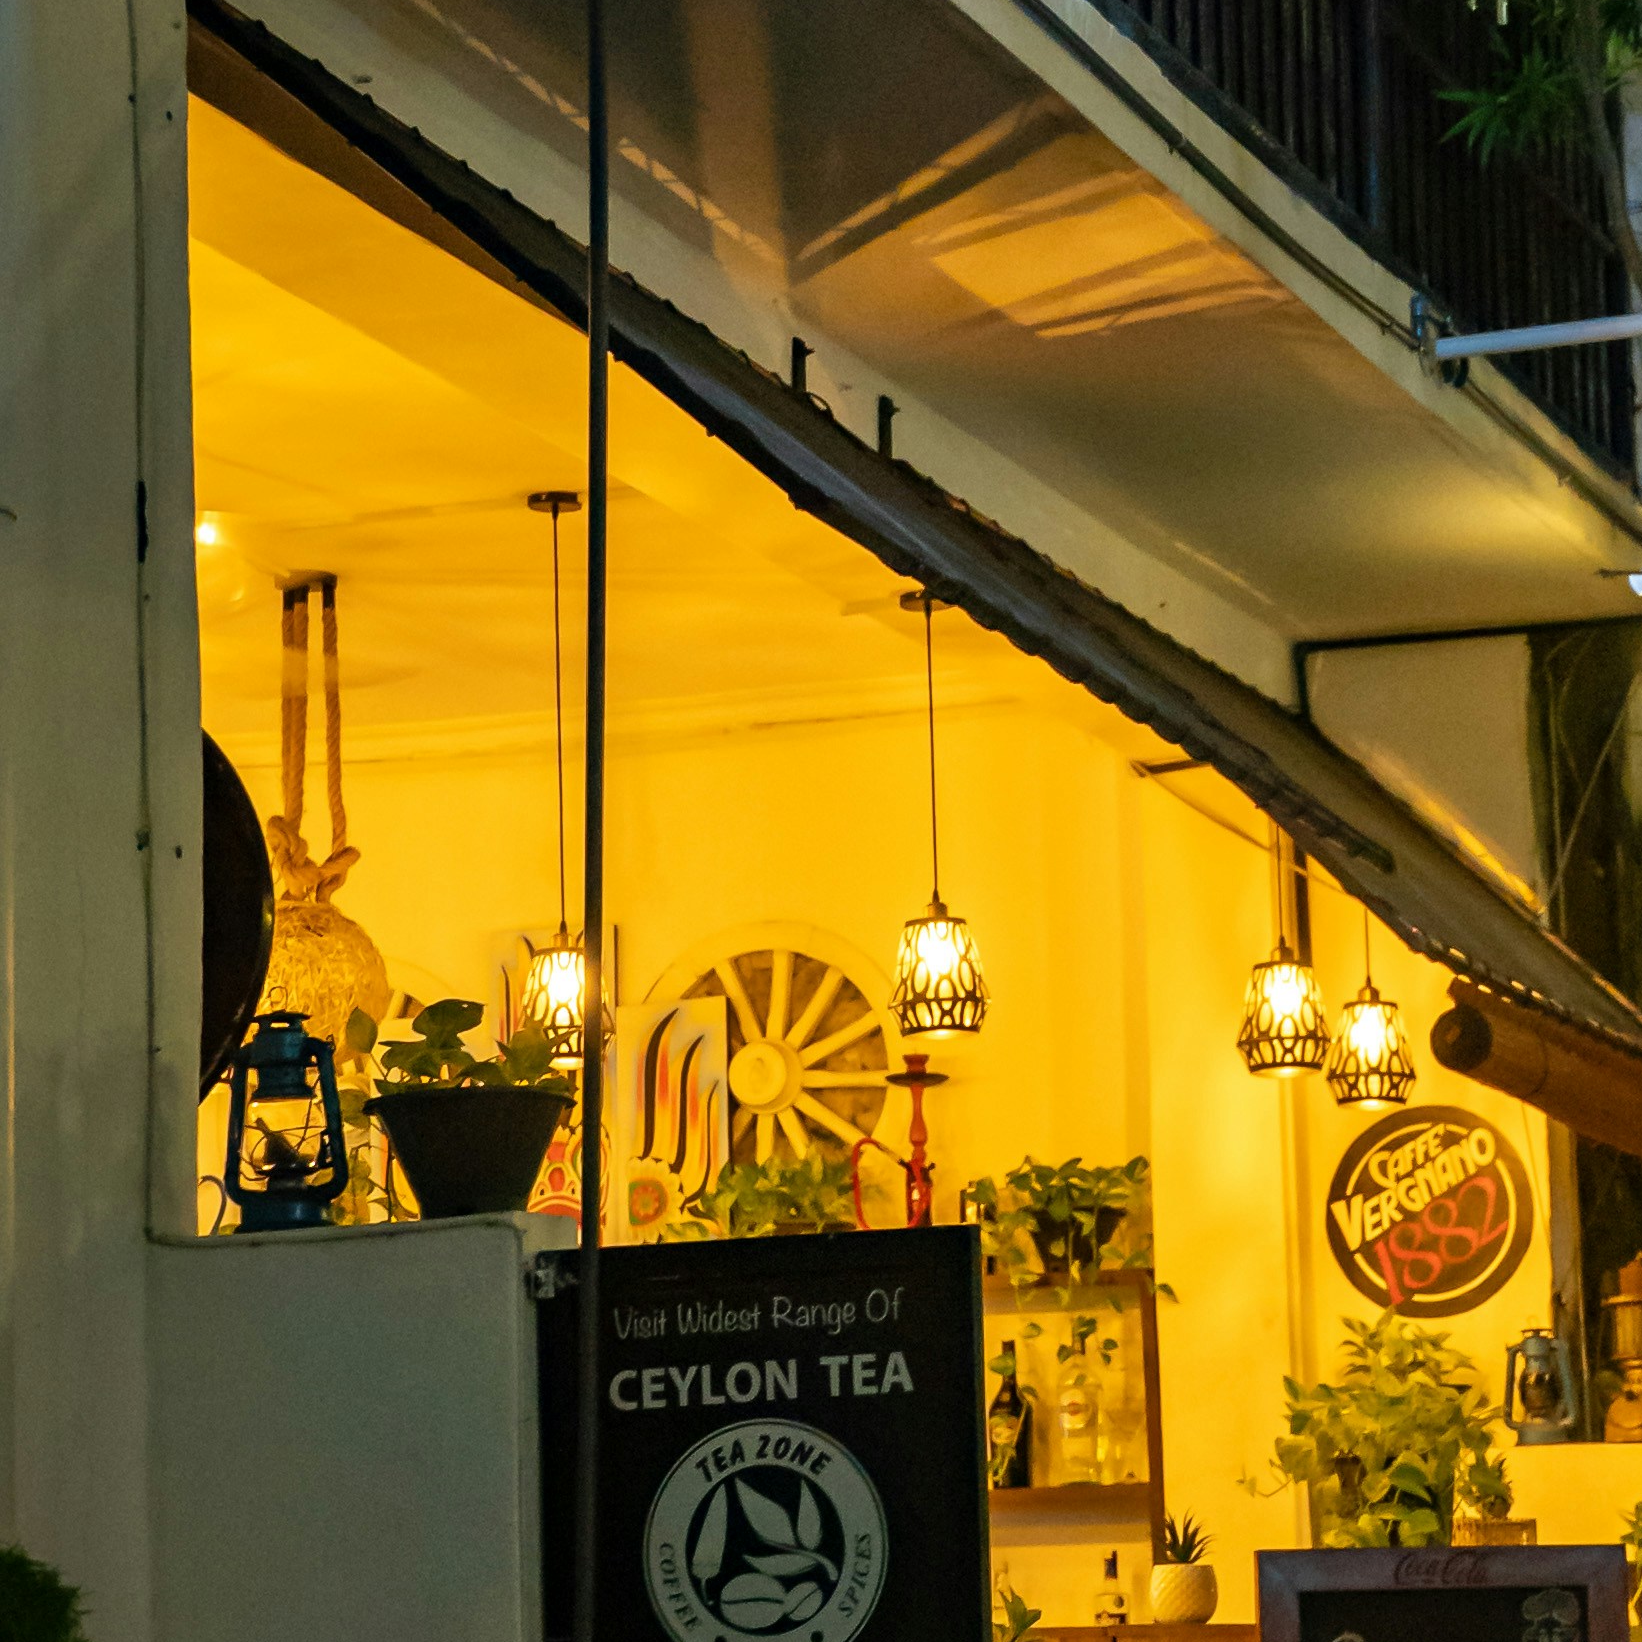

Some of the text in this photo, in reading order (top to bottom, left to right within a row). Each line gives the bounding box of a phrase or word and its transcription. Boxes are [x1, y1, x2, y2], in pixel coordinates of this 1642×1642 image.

[1330, 1127, 1496, 1252] VERGNANO
[1373, 1175, 1510, 1305] 1882
[613, 1287, 905, 1340] Visit Widest Range Of
[608, 1351, 915, 1412] CEYLON TEA
[694, 1434, 832, 1484] TEA ZONE
[837, 1531, 873, 1619] SPICES
